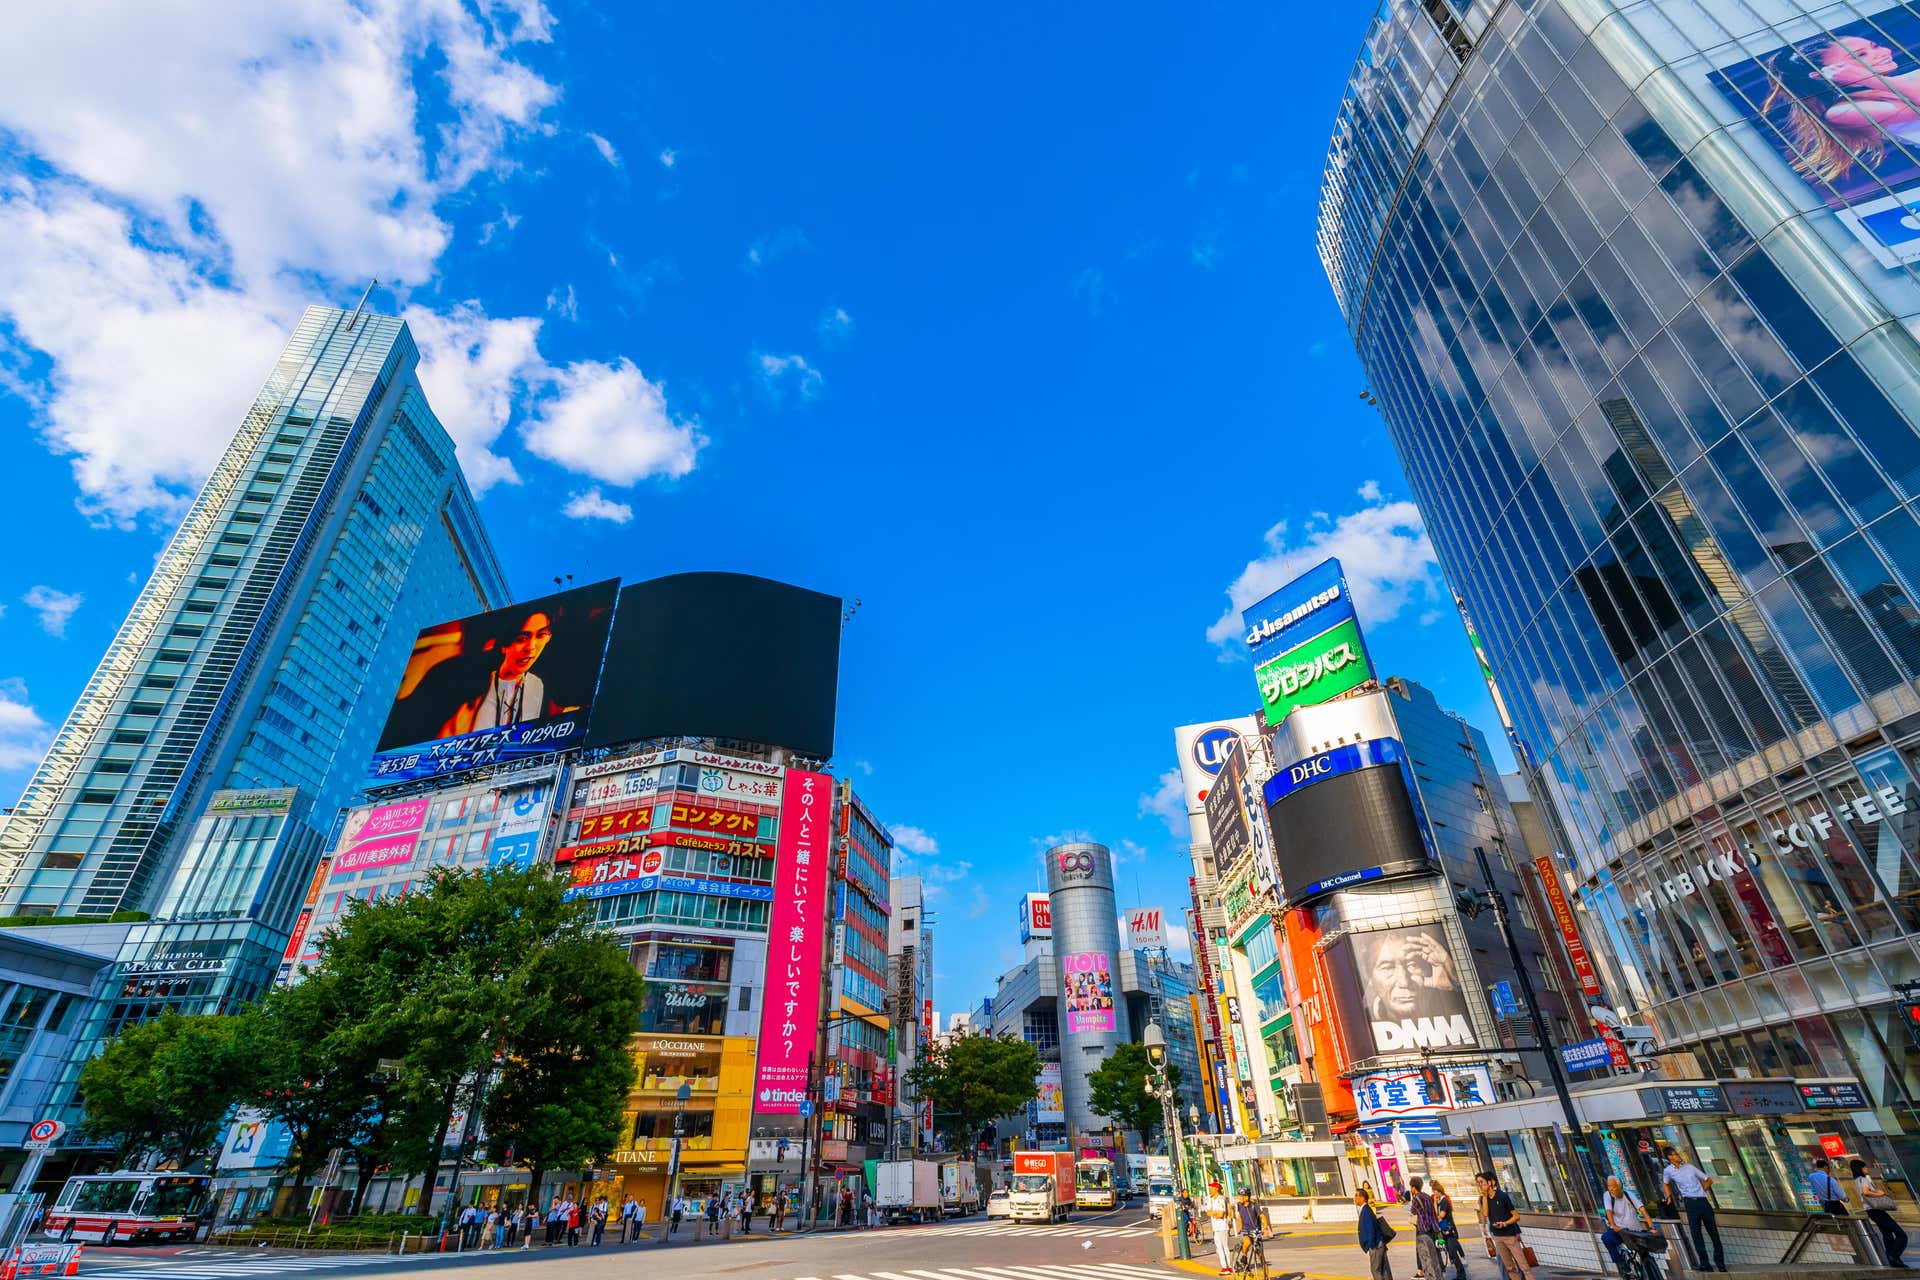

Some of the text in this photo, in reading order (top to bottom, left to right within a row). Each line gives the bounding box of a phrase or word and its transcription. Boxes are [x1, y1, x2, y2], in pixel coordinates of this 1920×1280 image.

[1246, 585, 1340, 644] Hisamitsu
[1262, 642, 1356, 704] サロンパス
[428, 721, 575, 759] スプリンターズ 9/29(日)
[376, 754, 420, 776] 第53回
[436, 747, 497, 772] ステークス
[694, 751, 780, 774] しゃぶしゃぶバイキング
[1290, 756, 1332, 785] DHC
[574, 788, 588, 799] 9F
[727, 775, 778, 797] しゃぶ葉
[385, 803, 426, 821] 品川スキン
[583, 809, 650, 836] プライス
[672, 806, 756, 832] コンタクト
[344, 842, 412, 866] 品川美容外科
[616, 835, 652, 854] ガスト
[727, 841, 767, 859] ガスト
[592, 858, 637, 883] ガスト
[1320, 872, 1361, 889] DHC Channel
[697, 881, 772, 898] 英会話イーオン
[780, 777, 816, 1059] その人と一緒にいて、楽しいですか？
[1130, 911, 1159, 933] H&M
[121, 959, 229, 973] MARK CITY
[152, 952, 204, 961] SHIBUYA
[1371, 1014, 1476, 1051] DMM
[652, 1039, 705, 1051] L'OCCITANE
[771, 1088, 807, 1102] tinder
[1669, 1098, 1703, 1109] 渋谷駅
[869, 1121, 885, 1139] LUSH
